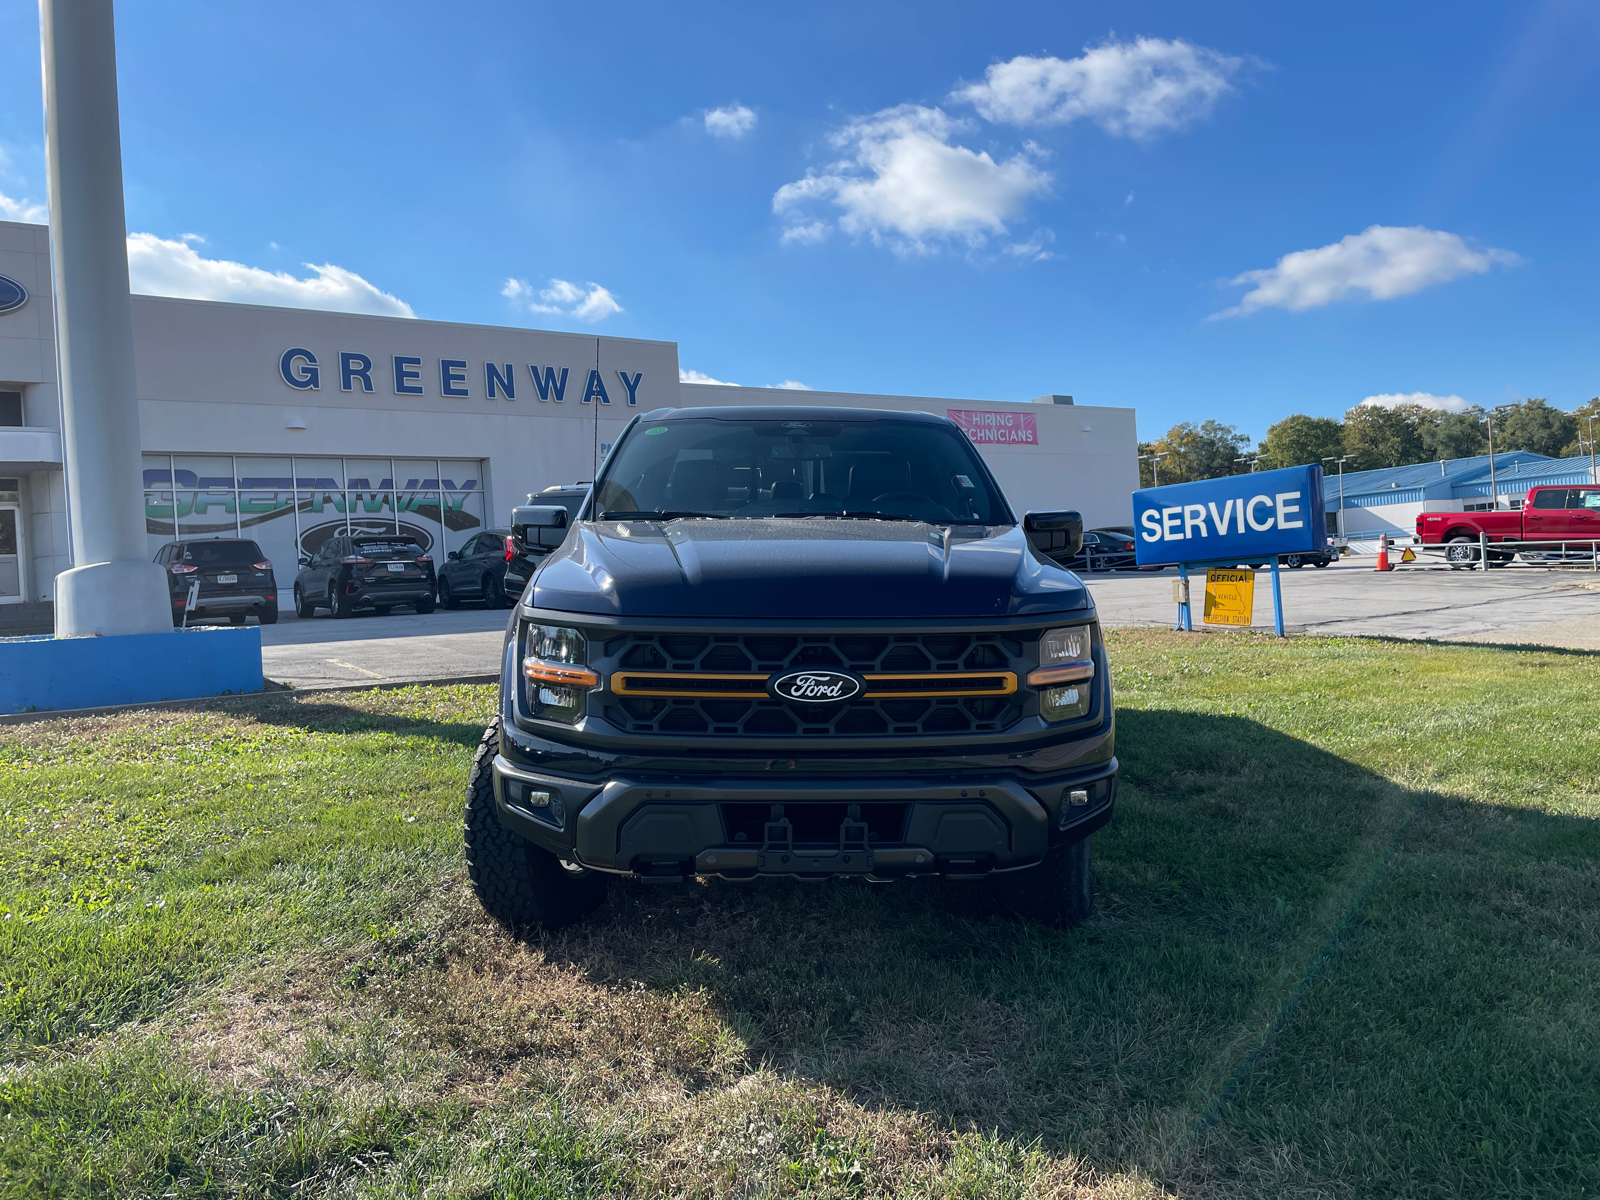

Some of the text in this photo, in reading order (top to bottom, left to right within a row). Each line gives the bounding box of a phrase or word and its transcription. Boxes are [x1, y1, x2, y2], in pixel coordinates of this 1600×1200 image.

[279, 347, 644, 406] GREENWAY
[972, 413, 1014, 426] HIRING
[963, 428, 1034, 442] CHNICIANS
[143, 469, 477, 518] GREENWAY
[1141, 491, 1303, 543] SERVICE
[1210, 574, 1250, 583] OFFICIAL
[1232, 615, 1249, 624] STATION
[790, 675, 843, 697] Ford
